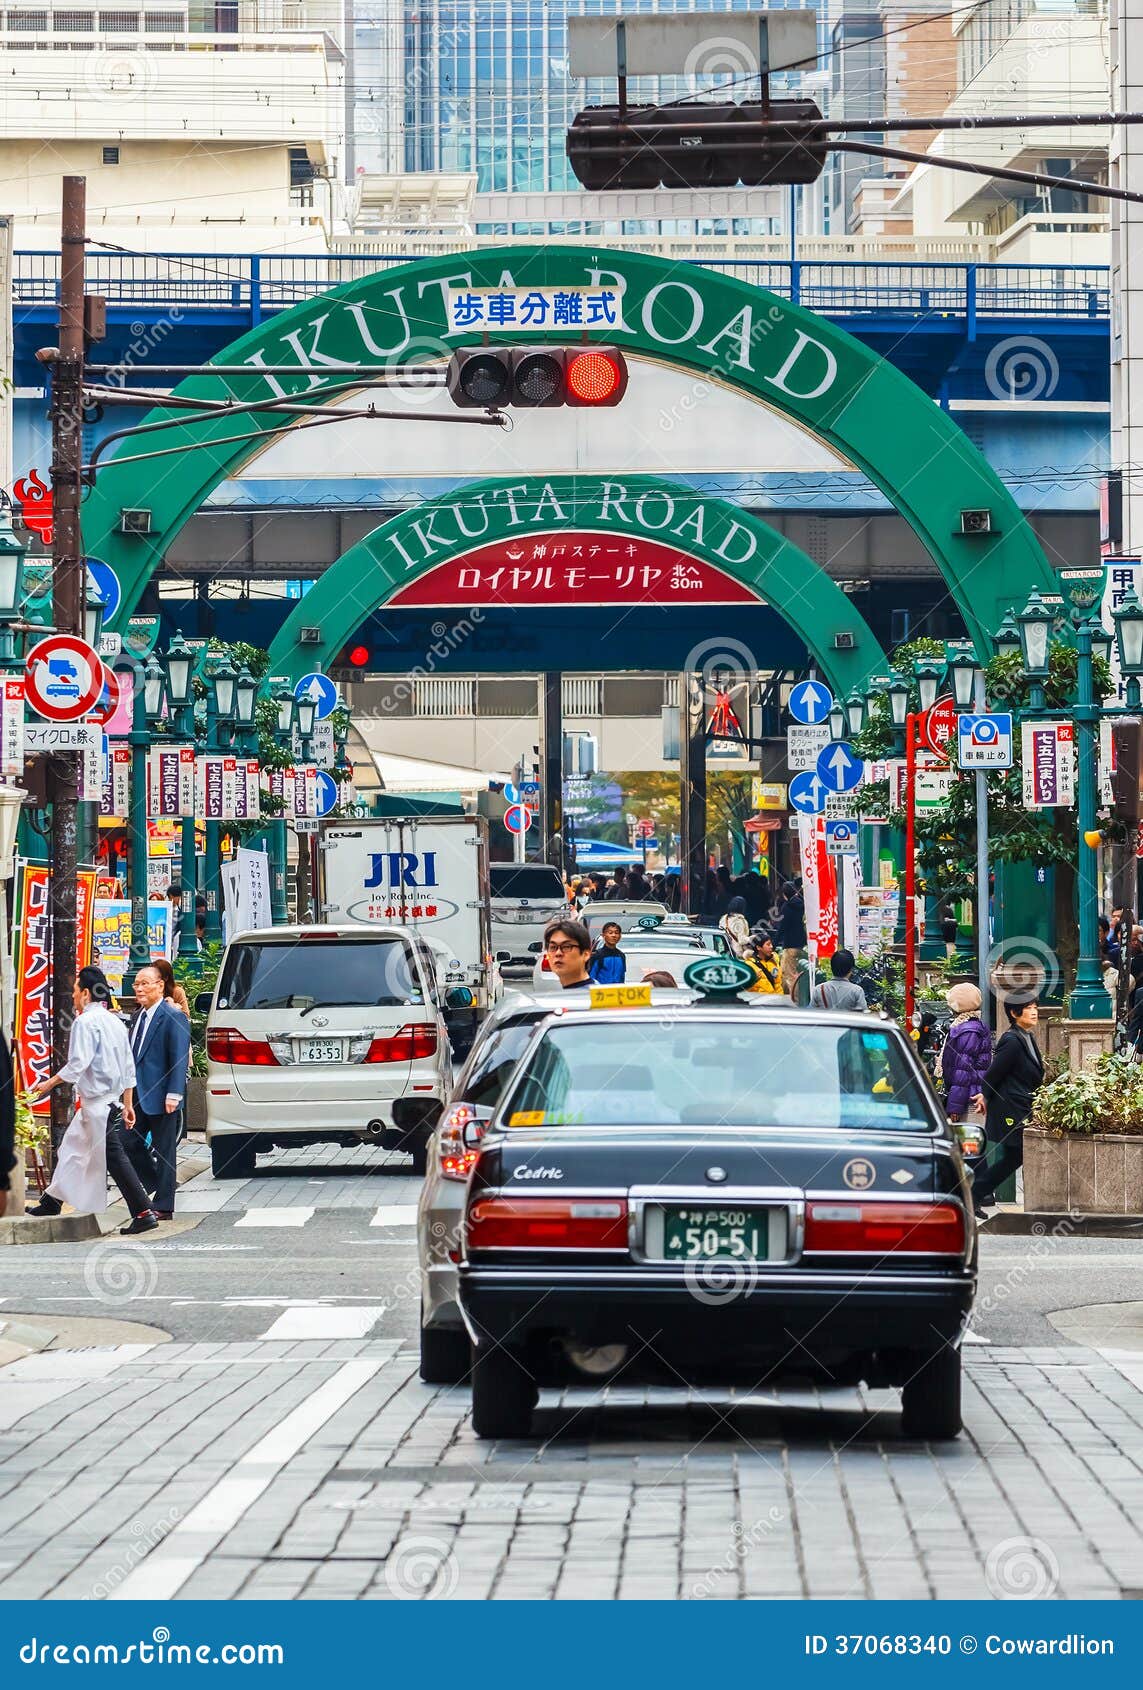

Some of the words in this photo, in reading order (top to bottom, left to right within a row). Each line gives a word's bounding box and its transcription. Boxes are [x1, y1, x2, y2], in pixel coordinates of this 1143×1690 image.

[453, 291, 616, 326] 歩車分離式
[385, 482, 570, 570] IKUTA
[597, 481, 758, 564] ROAD
[532, 543, 639, 559] 神戸ステーキ
[670, 577, 703, 590] 30m
[26, 729, 95, 744] マイクロを除く
[1058, 728, 1071, 739] 祝
[965, 751, 1007, 761] 車輪止め
[1038, 733, 1054, 801] 七五三まいり
[164, 755, 178, 813] 七五三まいり
[208, 764, 222, 816] 七五三まいり
[364, 851, 439, 888] JRI
[371, 893, 387, 902] Joy
[390, 893, 414, 901] Road
[417, 893, 435, 901] Inc.
[595, 988, 646, 1002] カードOK
[308, 1048, 340, 1060] 63-53
[513, 1165, 564, 1181] Cedric
[686, 1228, 758, 1256] 50-51
